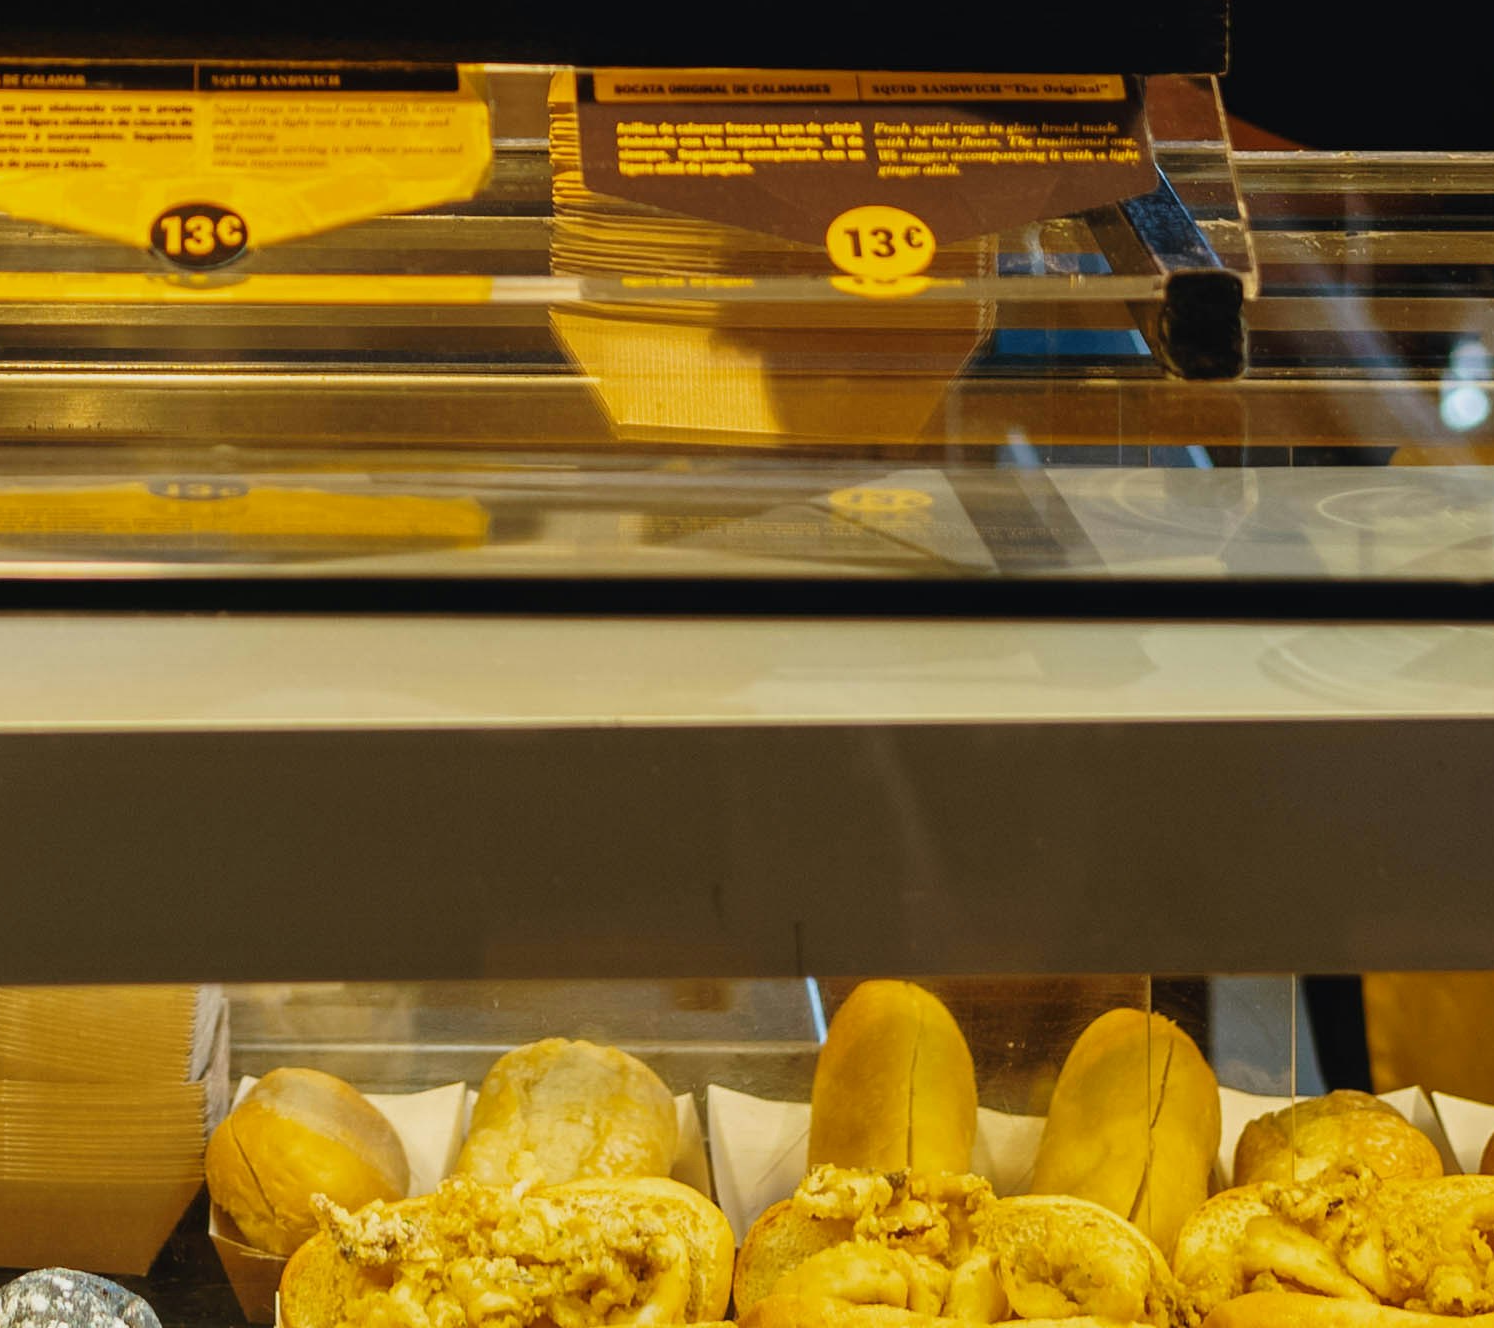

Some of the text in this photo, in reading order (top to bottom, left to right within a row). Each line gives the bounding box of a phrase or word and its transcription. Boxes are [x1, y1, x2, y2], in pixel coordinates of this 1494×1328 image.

[2, 74, 20, 86] DE
[615, 84, 665, 94] BOCATA
[872, 84, 916, 94] SQUID
[921, 84, 1001, 93] SANDWICH
[874, 122, 911, 134] Fresh
[914, 122, 951, 136] squid
[953, 123, 987, 136] rings
[989, 122, 1003, 134] in
[875, 136, 907, 148] with
[909, 136, 929, 148] the
[1062, 150, 1094, 161] with
[1096, 151, 1106, 161] a
[878, 164, 920, 177] ginger
[158, 213, 244, 256] 13€
[841, 224, 925, 260] 13€
